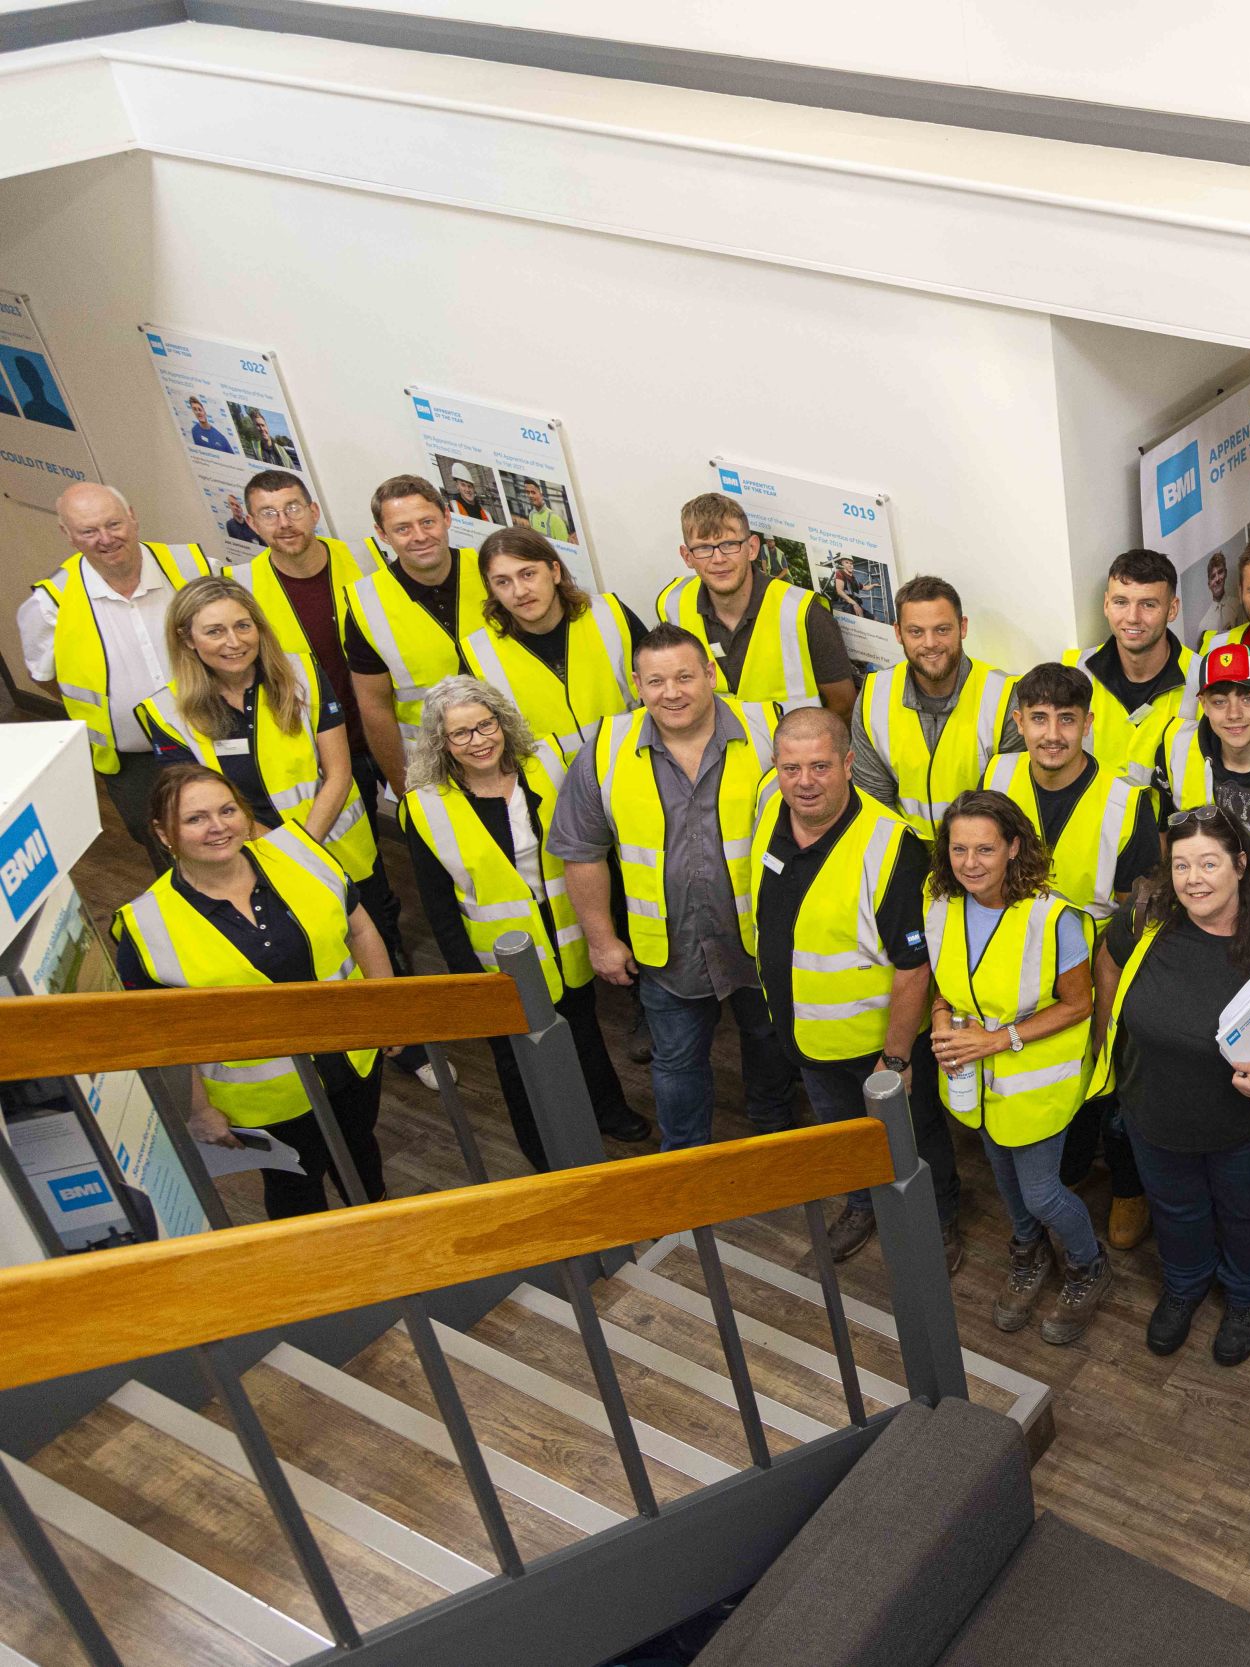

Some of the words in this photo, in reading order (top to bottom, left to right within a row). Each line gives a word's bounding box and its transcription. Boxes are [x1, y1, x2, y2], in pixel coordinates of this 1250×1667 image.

[240, 360, 267, 374] 2022
[520, 427, 550, 444] 2021
[0, 450, 35, 468] COULD
[35, 458, 45, 471] IT
[45, 462, 60, 475] BE
[58, 465, 86, 481] YOU?
[1209, 463, 1226, 484] OF
[1227, 449, 1247, 472] THE
[743, 479, 775, 491] APPRENTICE
[1163, 467, 1196, 510] BMI
[842, 503, 875, 520] 2019
[0, 829, 48, 897] BMI
[59, 1182, 104, 1201] BMI
